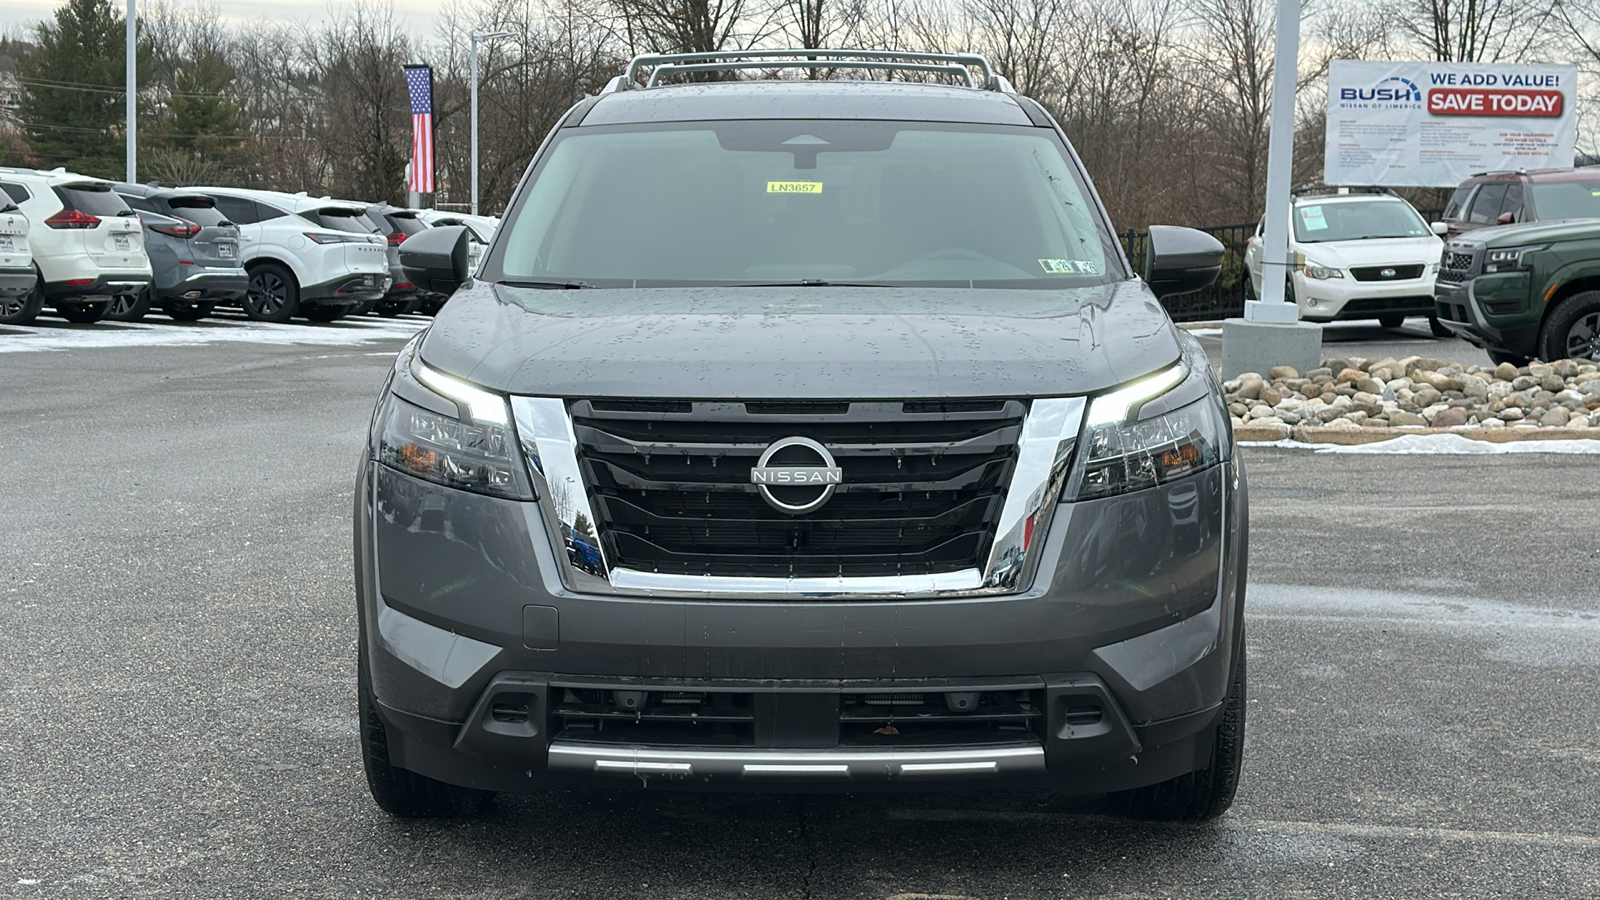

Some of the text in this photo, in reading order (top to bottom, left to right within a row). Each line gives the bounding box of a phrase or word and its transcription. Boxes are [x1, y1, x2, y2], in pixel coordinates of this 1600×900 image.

[1430, 73, 1560, 87] WE ADD VALUE!
[1340, 88, 1411, 101] BUSH
[1430, 93, 1559, 112] SAVE TODAY
[771, 183, 817, 192] LN3657
[753, 470, 840, 483] NISSAN
